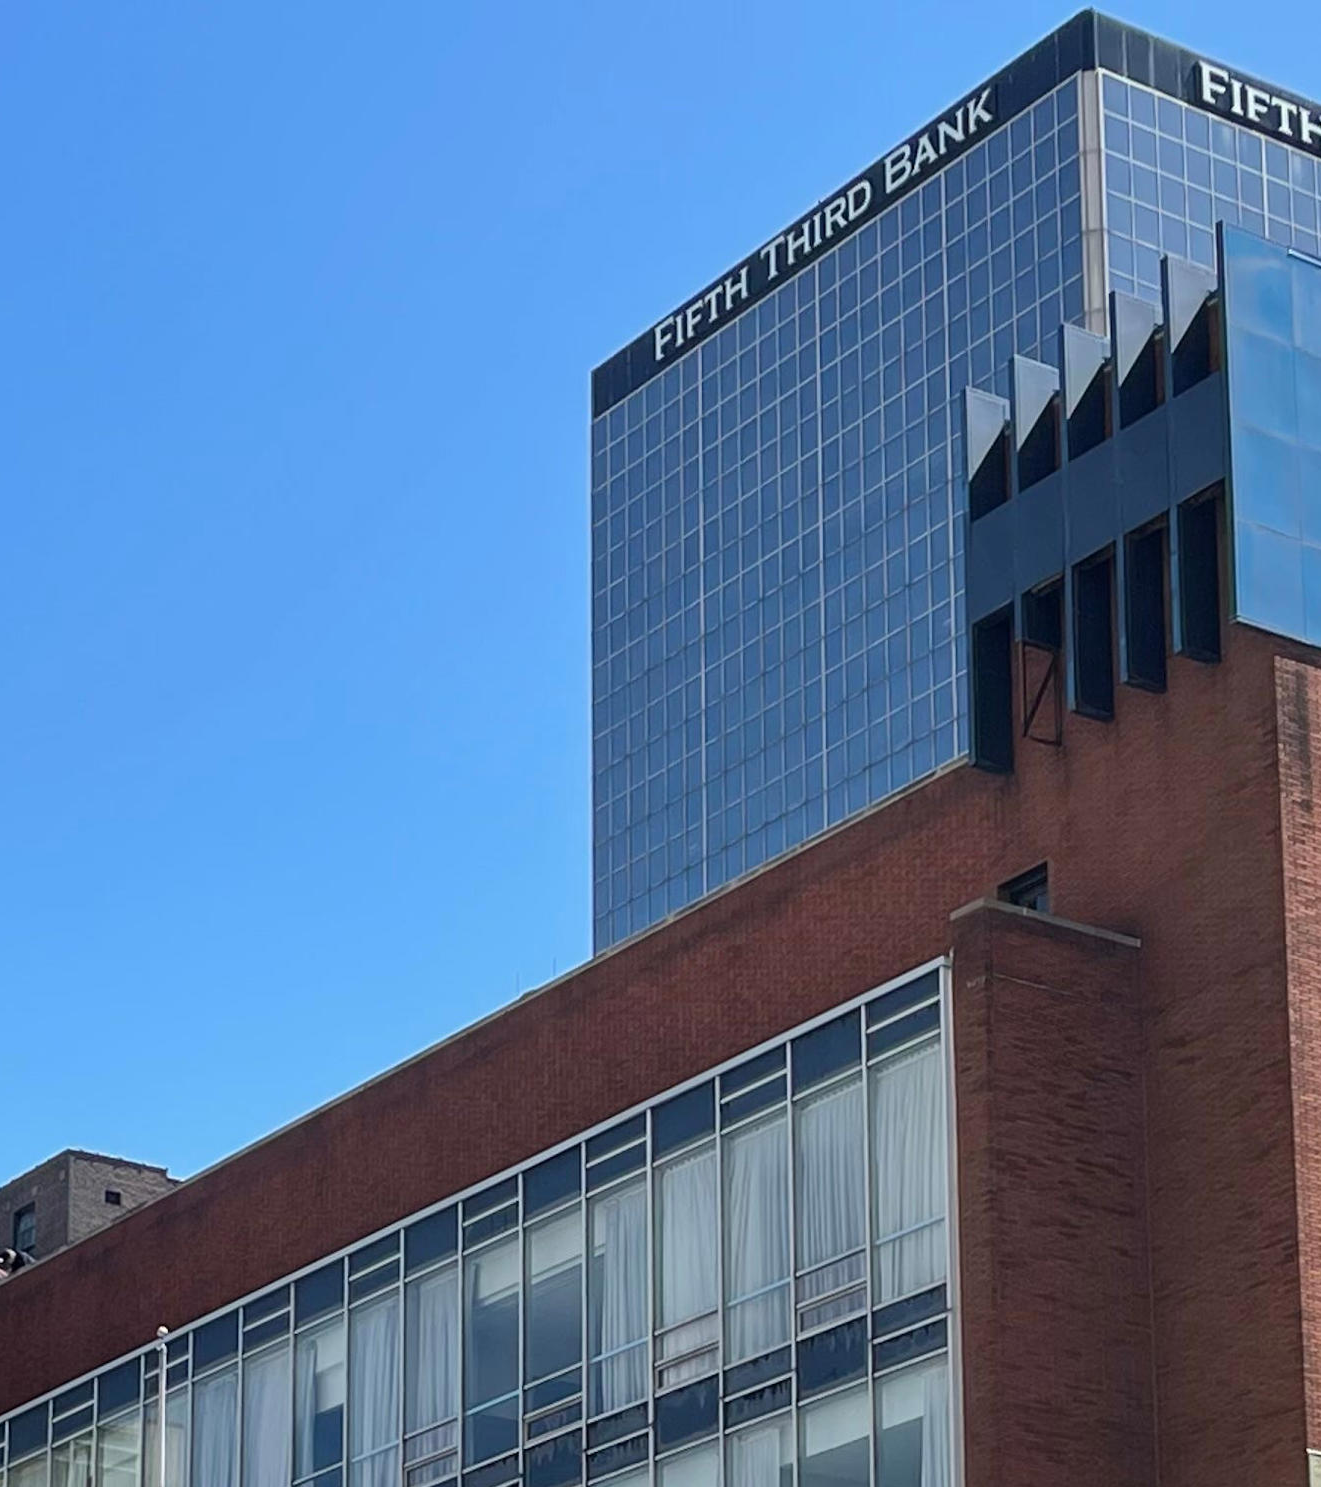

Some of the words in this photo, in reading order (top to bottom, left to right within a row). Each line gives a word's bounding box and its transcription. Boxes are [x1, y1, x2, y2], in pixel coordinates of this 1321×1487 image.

[654, 265, 749, 361] FIFTH
[760, 180, 871, 280] THIRD
[883, 88, 993, 194] BANK
